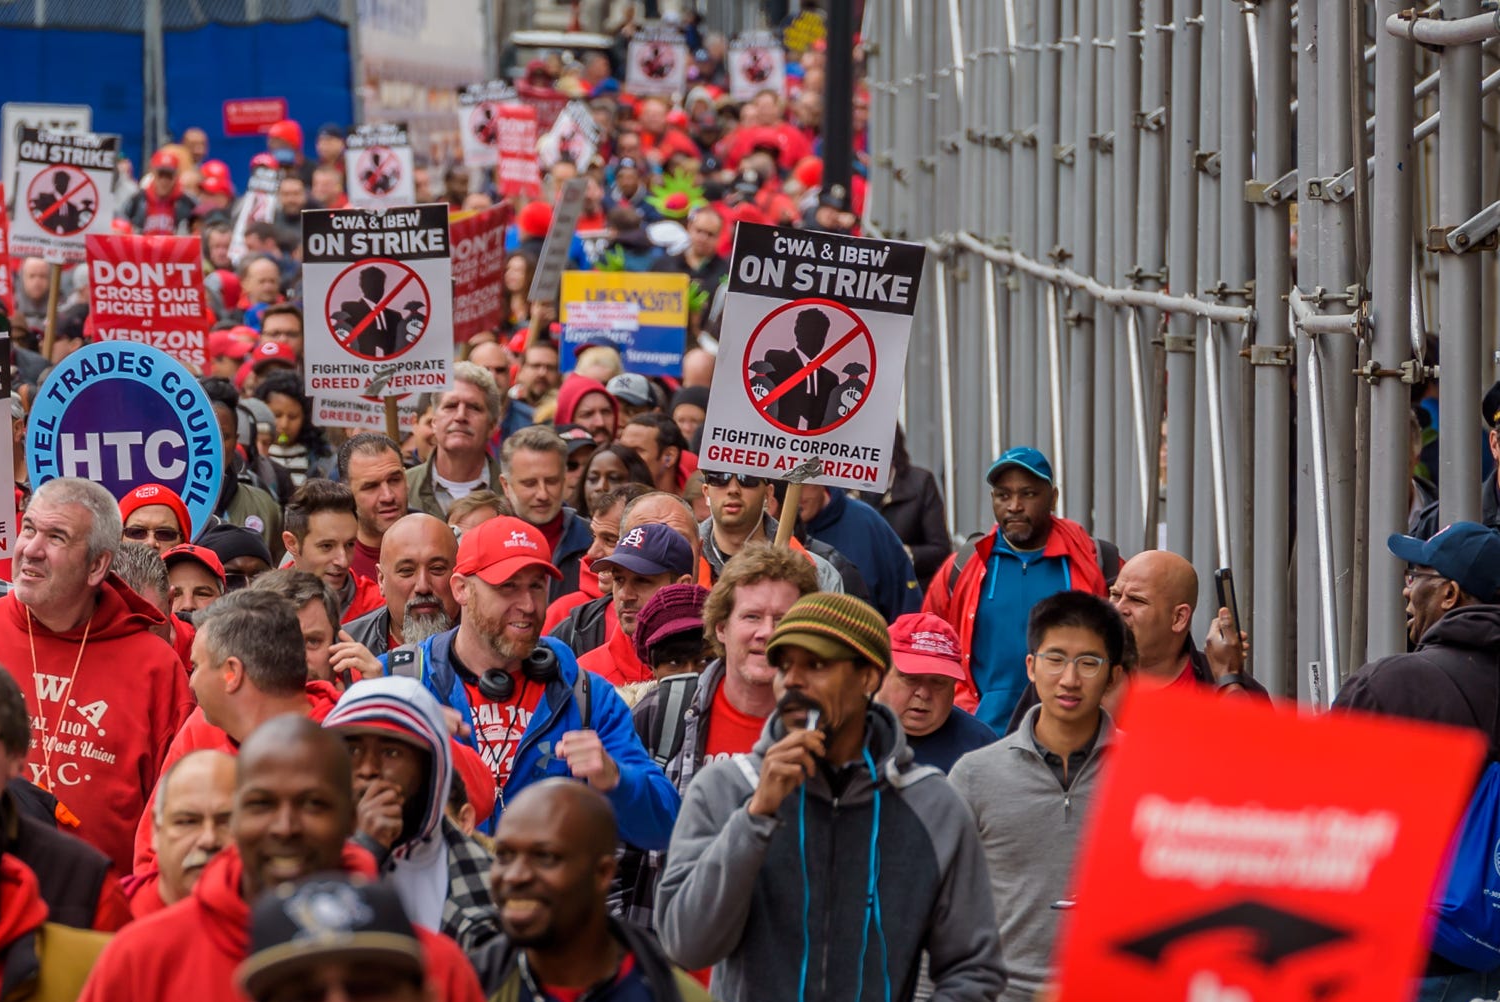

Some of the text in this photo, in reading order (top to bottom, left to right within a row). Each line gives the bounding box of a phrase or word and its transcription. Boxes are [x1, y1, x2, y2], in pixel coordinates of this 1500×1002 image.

[20, 141, 116, 168] ON STRIKE
[332, 212, 420, 230] CWA & IBEW
[308, 228, 445, 256] ON STRIKE
[774, 236, 888, 267] CWA & IBEW
[93, 260, 196, 286] DON'T
[739, 255, 912, 304] ON STRIKE
[95, 286, 198, 302] CROSS OUR
[96, 301, 201, 317] PICKET LINE
[99, 329, 204, 348] VERIZON
[312, 364, 369, 374] FIGHTING
[311, 378, 359, 389] GREED
[387, 373, 446, 389] VERIZON
[320, 399, 371, 412] FIGHTING
[48, 352, 154, 405] TRADES
[161, 371, 214, 506] COUNCIL
[319, 410, 362, 422] GREED
[365, 414, 380, 425] AT
[60, 429, 187, 481] HTC
[712, 427, 881, 462] FIGHTING CORPORATE
[707, 445, 878, 482] GREED AT RIZON
[60, 720, 88, 737] 1101
[80, 741, 116, 764] Union
